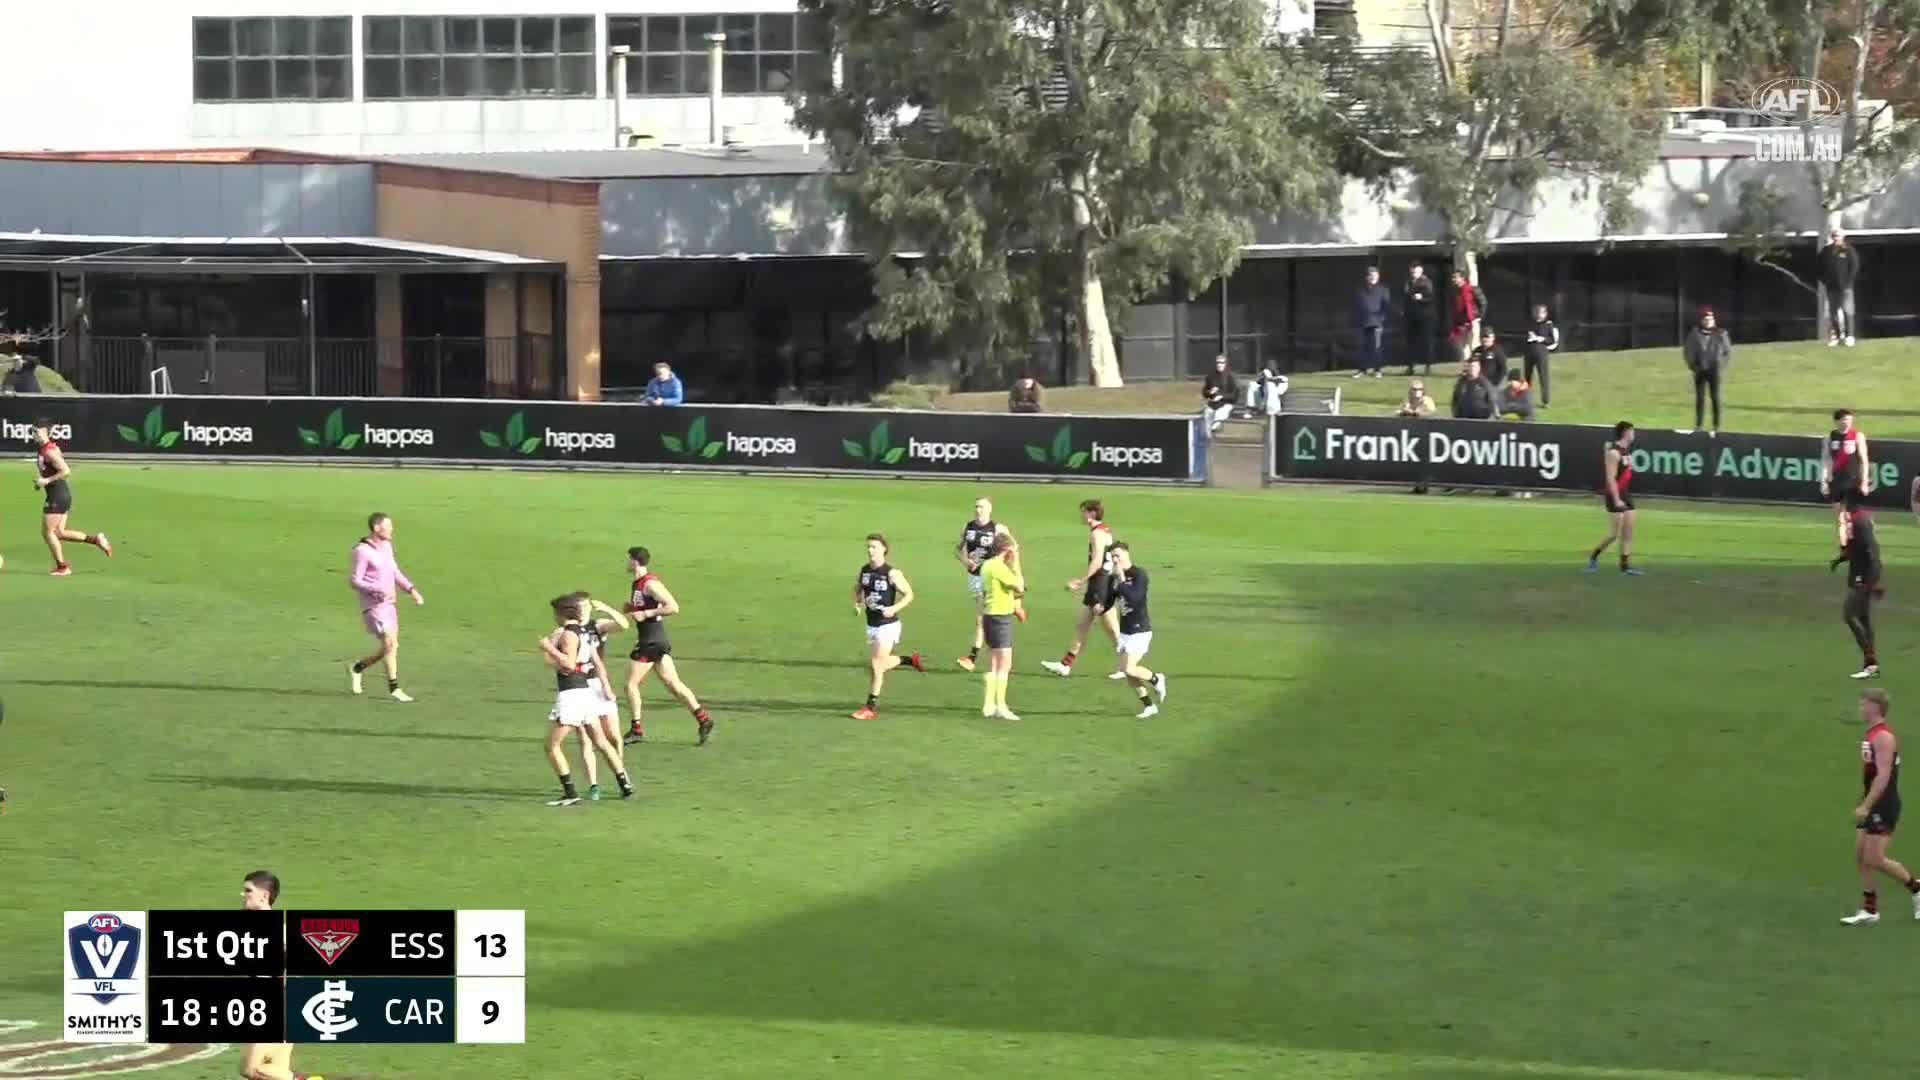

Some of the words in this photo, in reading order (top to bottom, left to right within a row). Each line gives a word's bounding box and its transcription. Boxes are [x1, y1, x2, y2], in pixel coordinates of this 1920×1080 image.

[3, 419, 72, 444] hapsa
[184, 420, 253, 446] happsa
[365, 424, 434, 449] happsa
[546, 427, 615, 453] happsa
[727, 432, 796, 457] happsa
[909, 437, 979, 463] happsa
[1091, 442, 1163, 468] happsa
[1325, 428, 1426, 463] Frank
[1430, 431, 1561, 480] Dowling
[1631, 448, 1705, 476] ome
